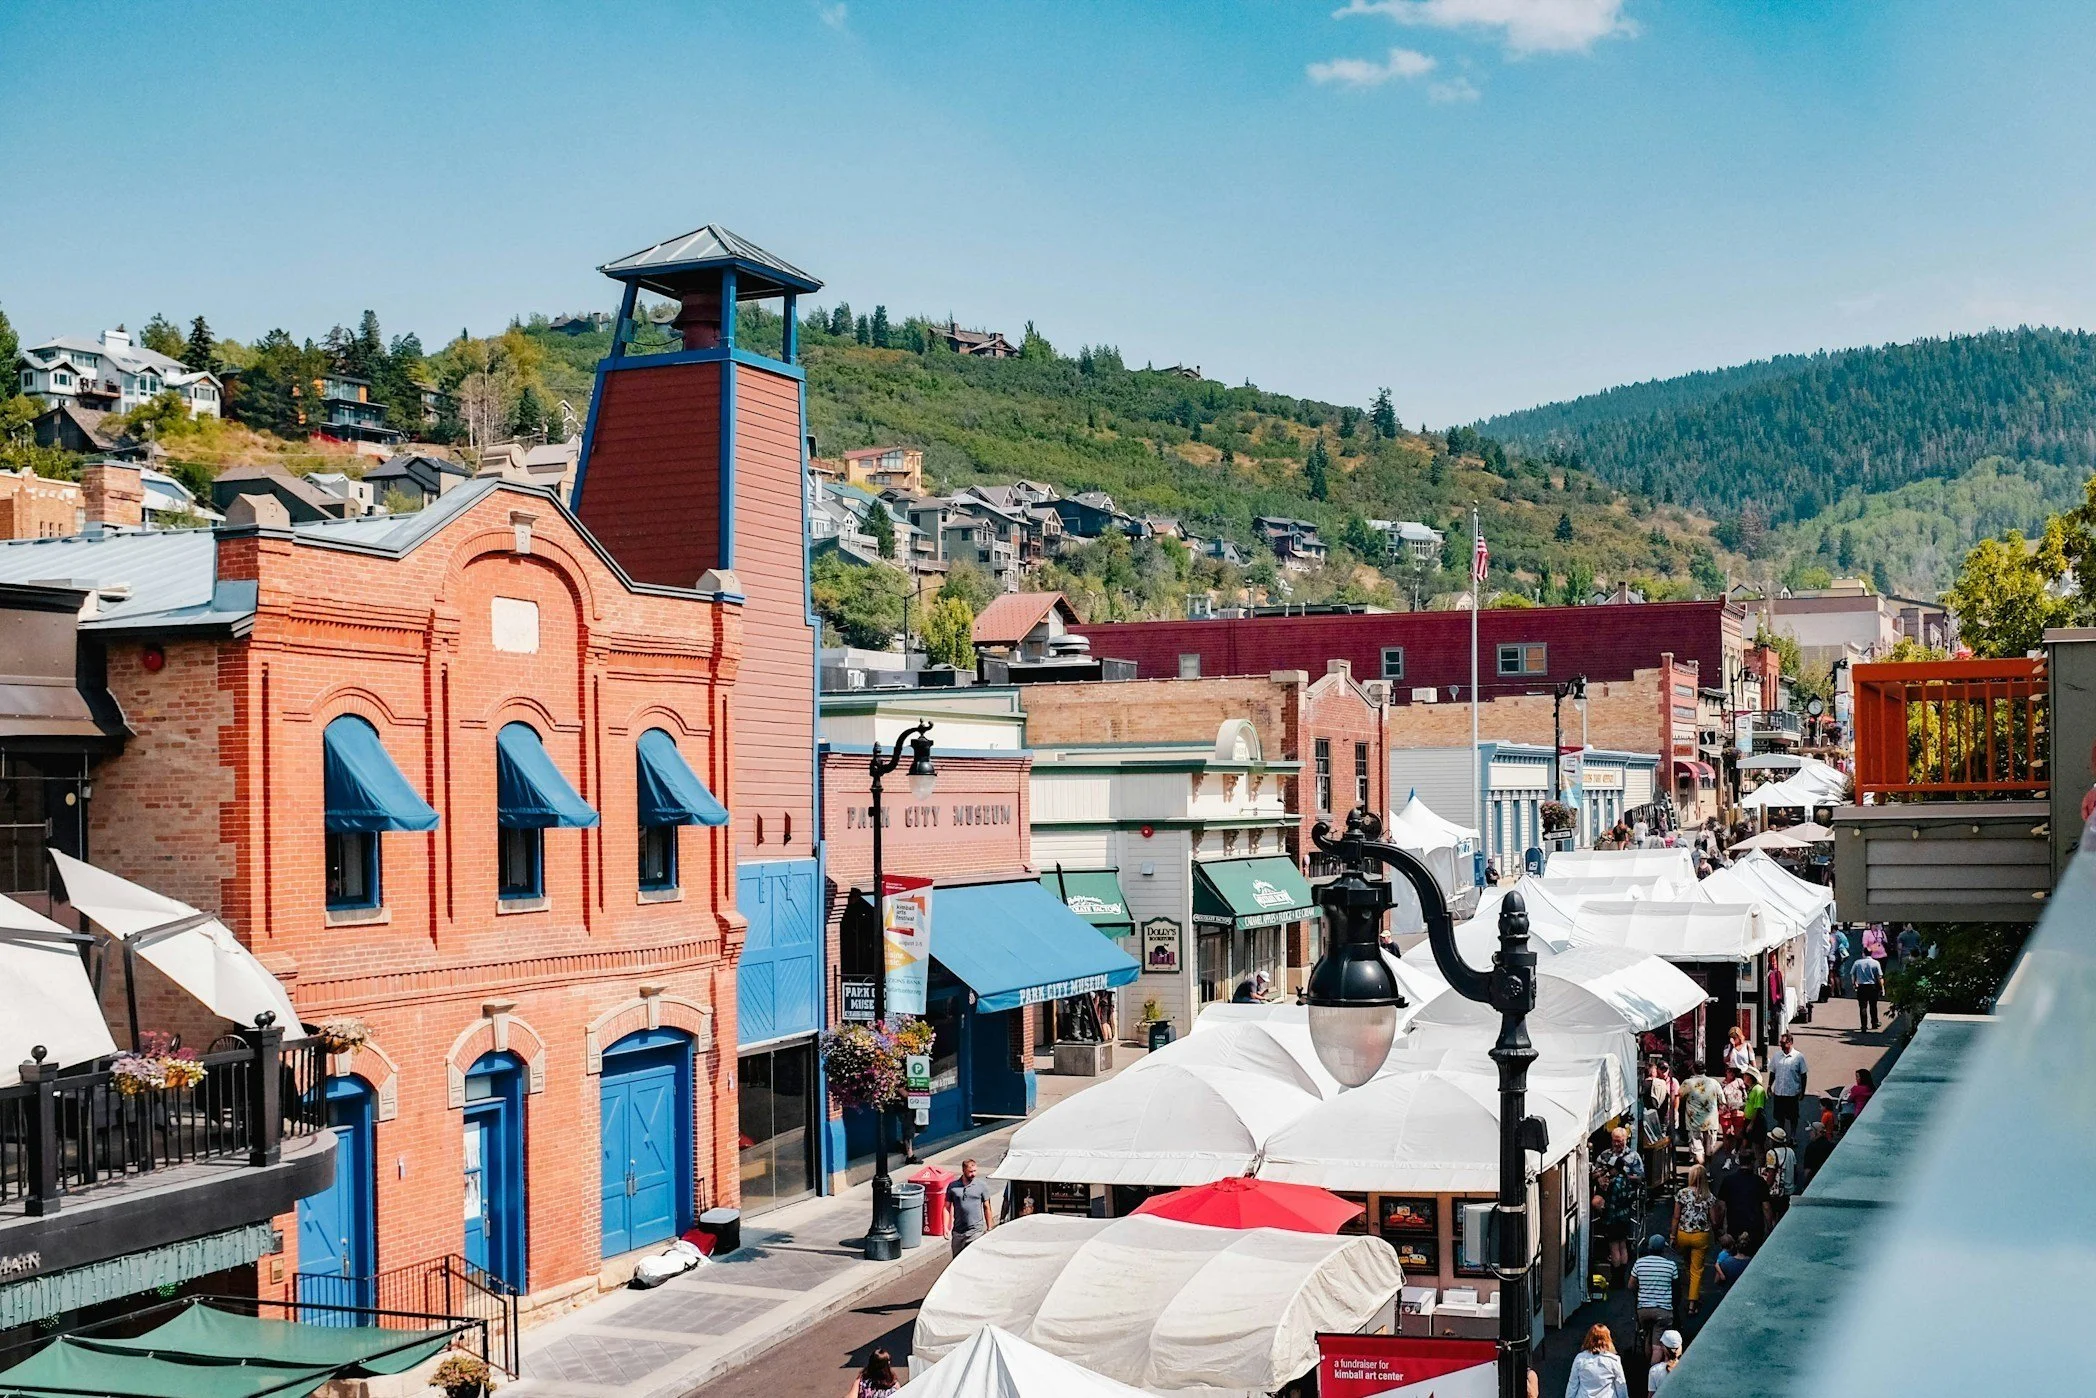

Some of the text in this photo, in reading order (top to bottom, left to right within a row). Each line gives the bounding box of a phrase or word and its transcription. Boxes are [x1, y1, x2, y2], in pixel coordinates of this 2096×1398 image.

[847, 804, 1011, 829] PAK CITY MUSEUM
[1147, 926, 1176, 936] DOLLY'S
[846, 987, 870, 998] PARK
[1020, 974, 1108, 1004] PARK CITY MUSEUM
[851, 999, 875, 1010] MUSE
[1340, 1358, 1377, 1369] fundraiser
[1379, 1360, 1389, 1370] for
[1334, 1369, 1404, 1380] kimball art center
